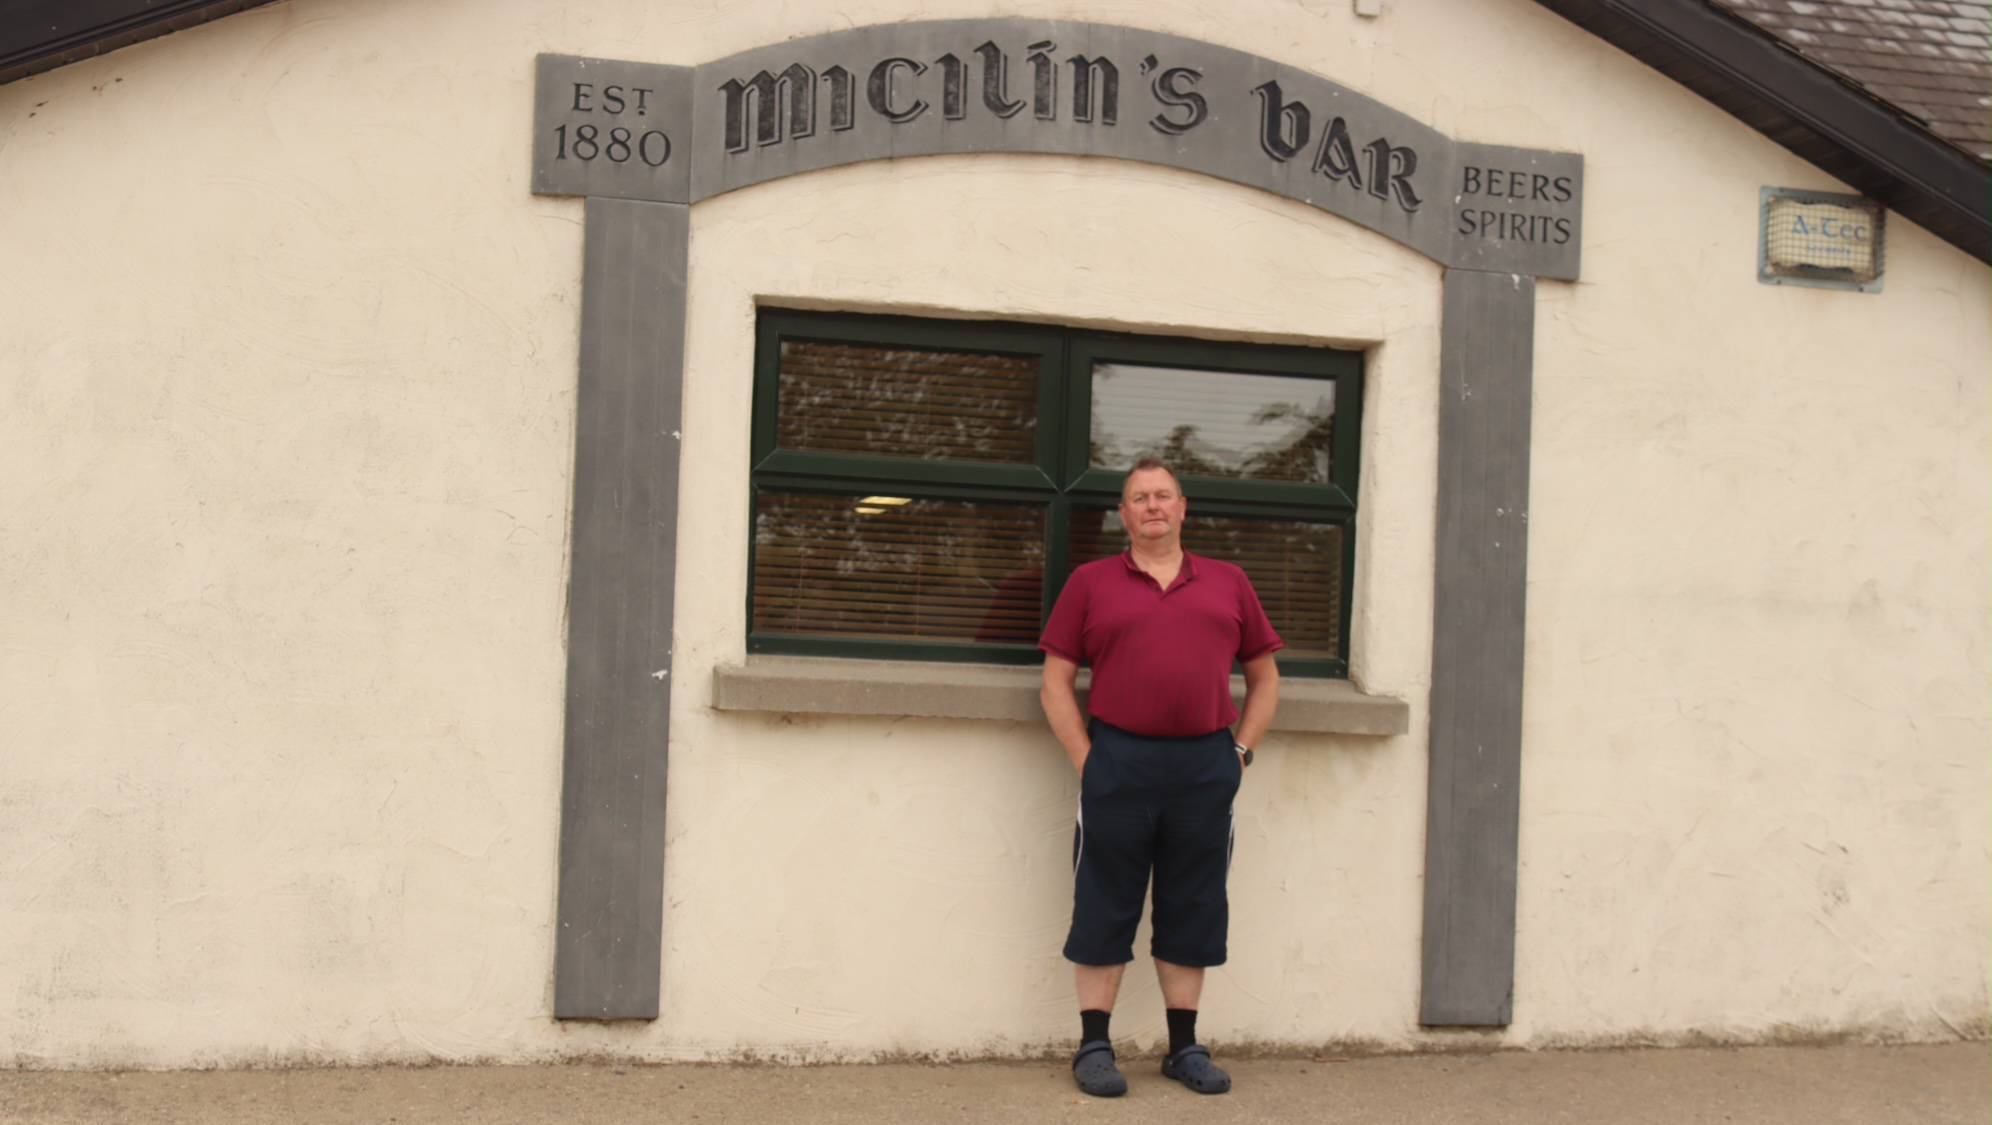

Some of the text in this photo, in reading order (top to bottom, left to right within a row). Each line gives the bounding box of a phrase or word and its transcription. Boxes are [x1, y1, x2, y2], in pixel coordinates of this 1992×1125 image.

[554, 123, 672, 167] 1880
[1462, 166, 1573, 203] BEERS
[1458, 208, 1572, 245] SPIRITS
